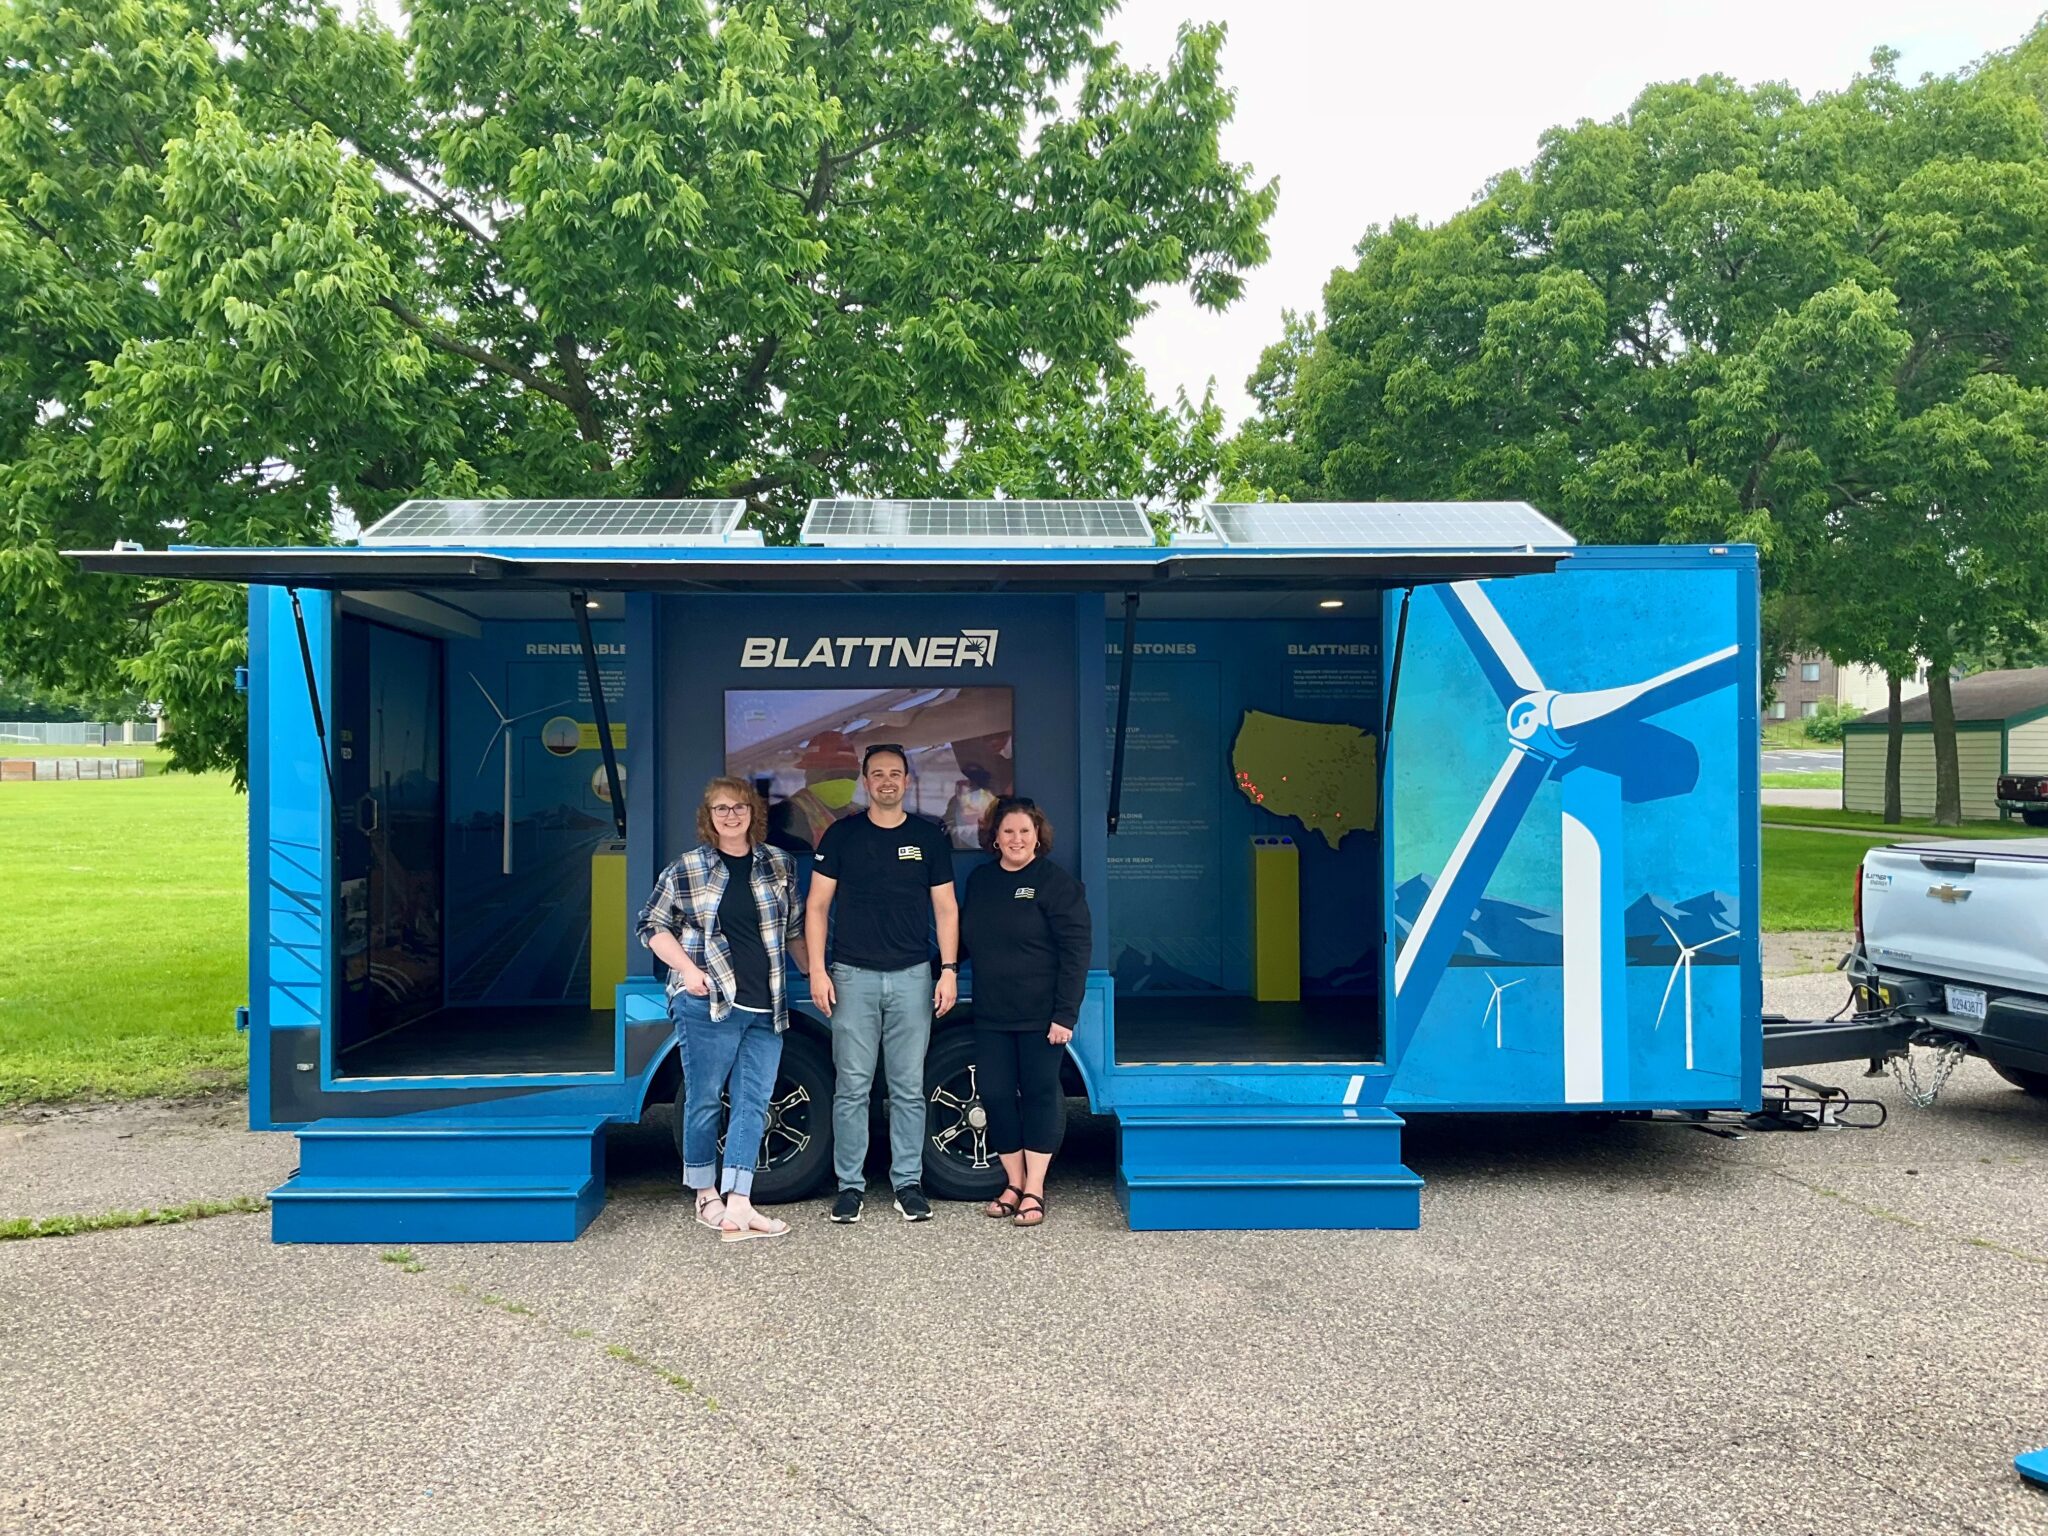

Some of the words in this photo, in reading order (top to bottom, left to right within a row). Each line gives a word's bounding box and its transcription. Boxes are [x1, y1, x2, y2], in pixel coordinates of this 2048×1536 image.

[526, 643, 626, 655] RENEWBLE
[740, 632, 997, 668] BLATTNER
[1104, 643, 1197, 654] ILSTONES
[1288, 644, 1370, 655] BLATTNER
